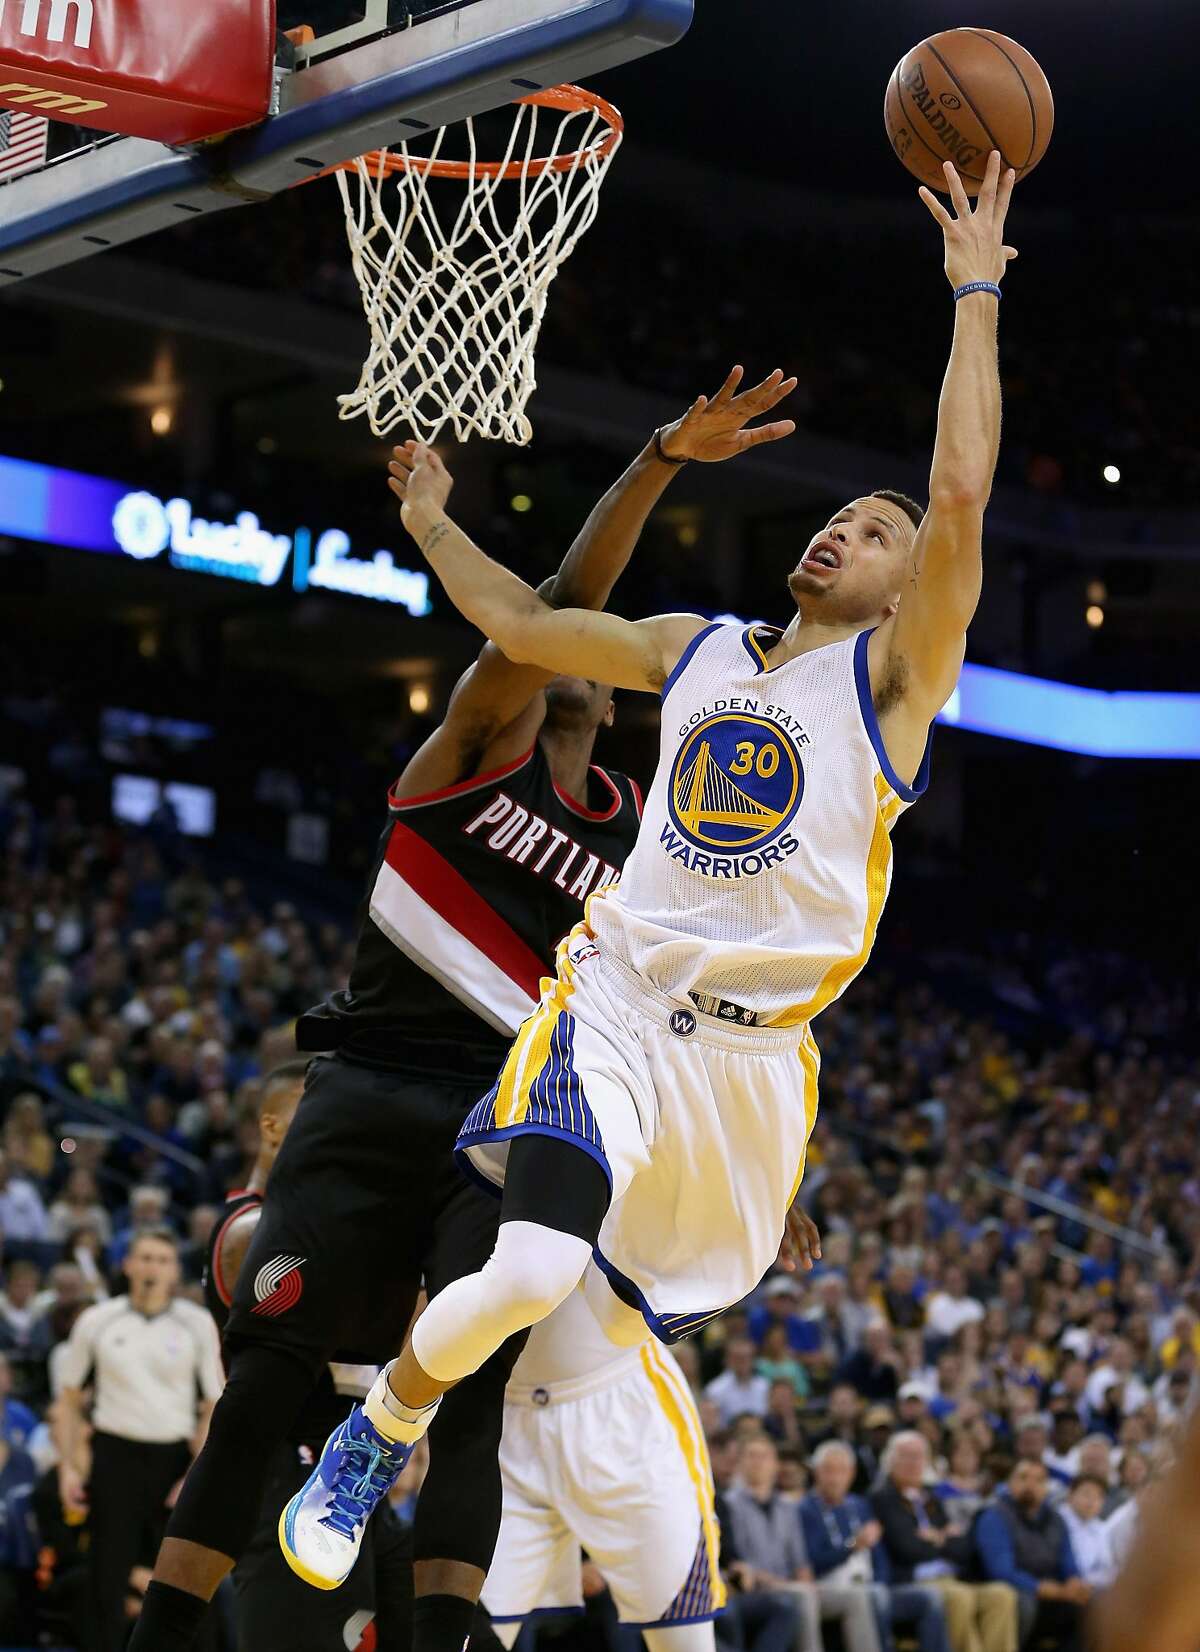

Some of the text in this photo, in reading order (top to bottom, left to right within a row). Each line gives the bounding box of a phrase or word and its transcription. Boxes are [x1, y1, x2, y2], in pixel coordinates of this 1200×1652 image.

[678, 698, 811, 748] GOLDEN STATE
[728, 741, 780, 779] 30
[659, 822, 800, 879] WARRIORS
